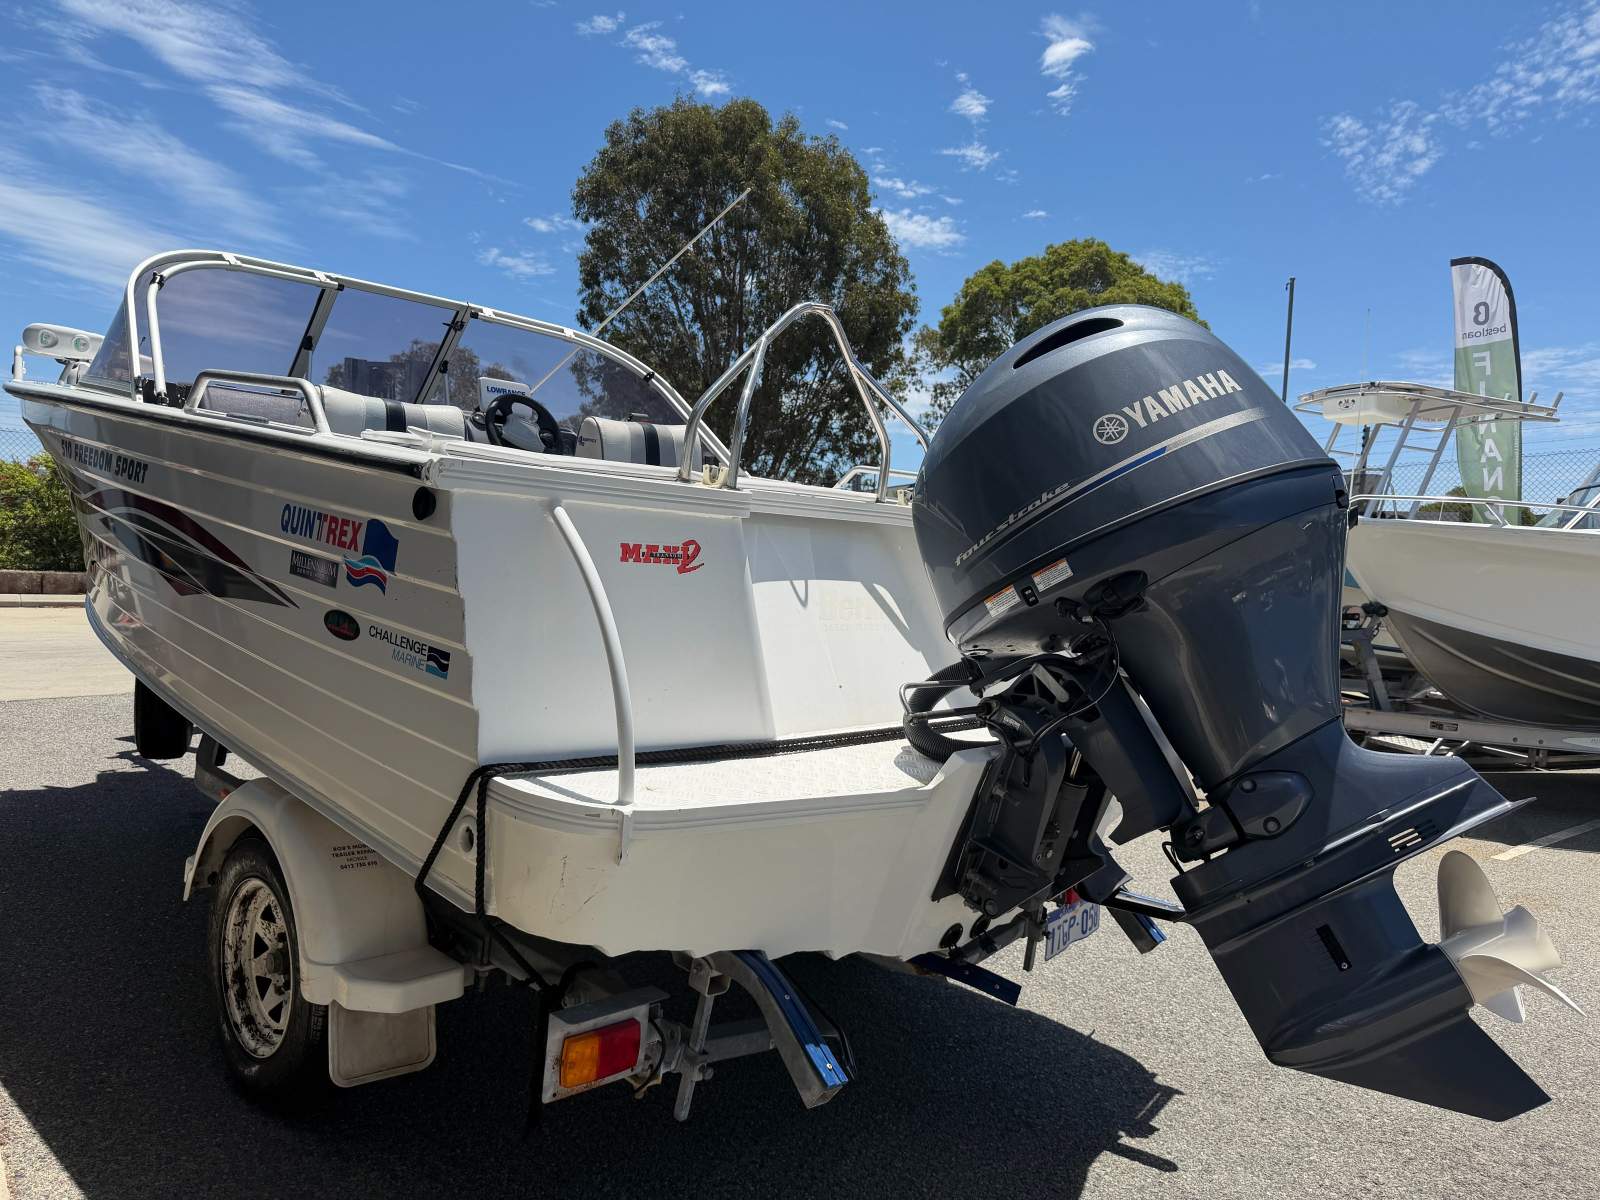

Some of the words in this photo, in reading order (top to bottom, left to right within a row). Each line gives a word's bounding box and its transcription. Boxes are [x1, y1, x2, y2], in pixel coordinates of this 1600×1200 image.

[1122, 369, 1243, 429] YAMAHA
[74, 443, 113, 472] FREEDOM
[114, 455, 149, 484] SPORT
[280, 503, 363, 552] QUINTREX
[954, 482, 1071, 567] fourstroke
[677, 539, 704, 574] 2
[368, 625, 428, 656] CHALLENGE
[391, 648, 426, 672] MARINE
